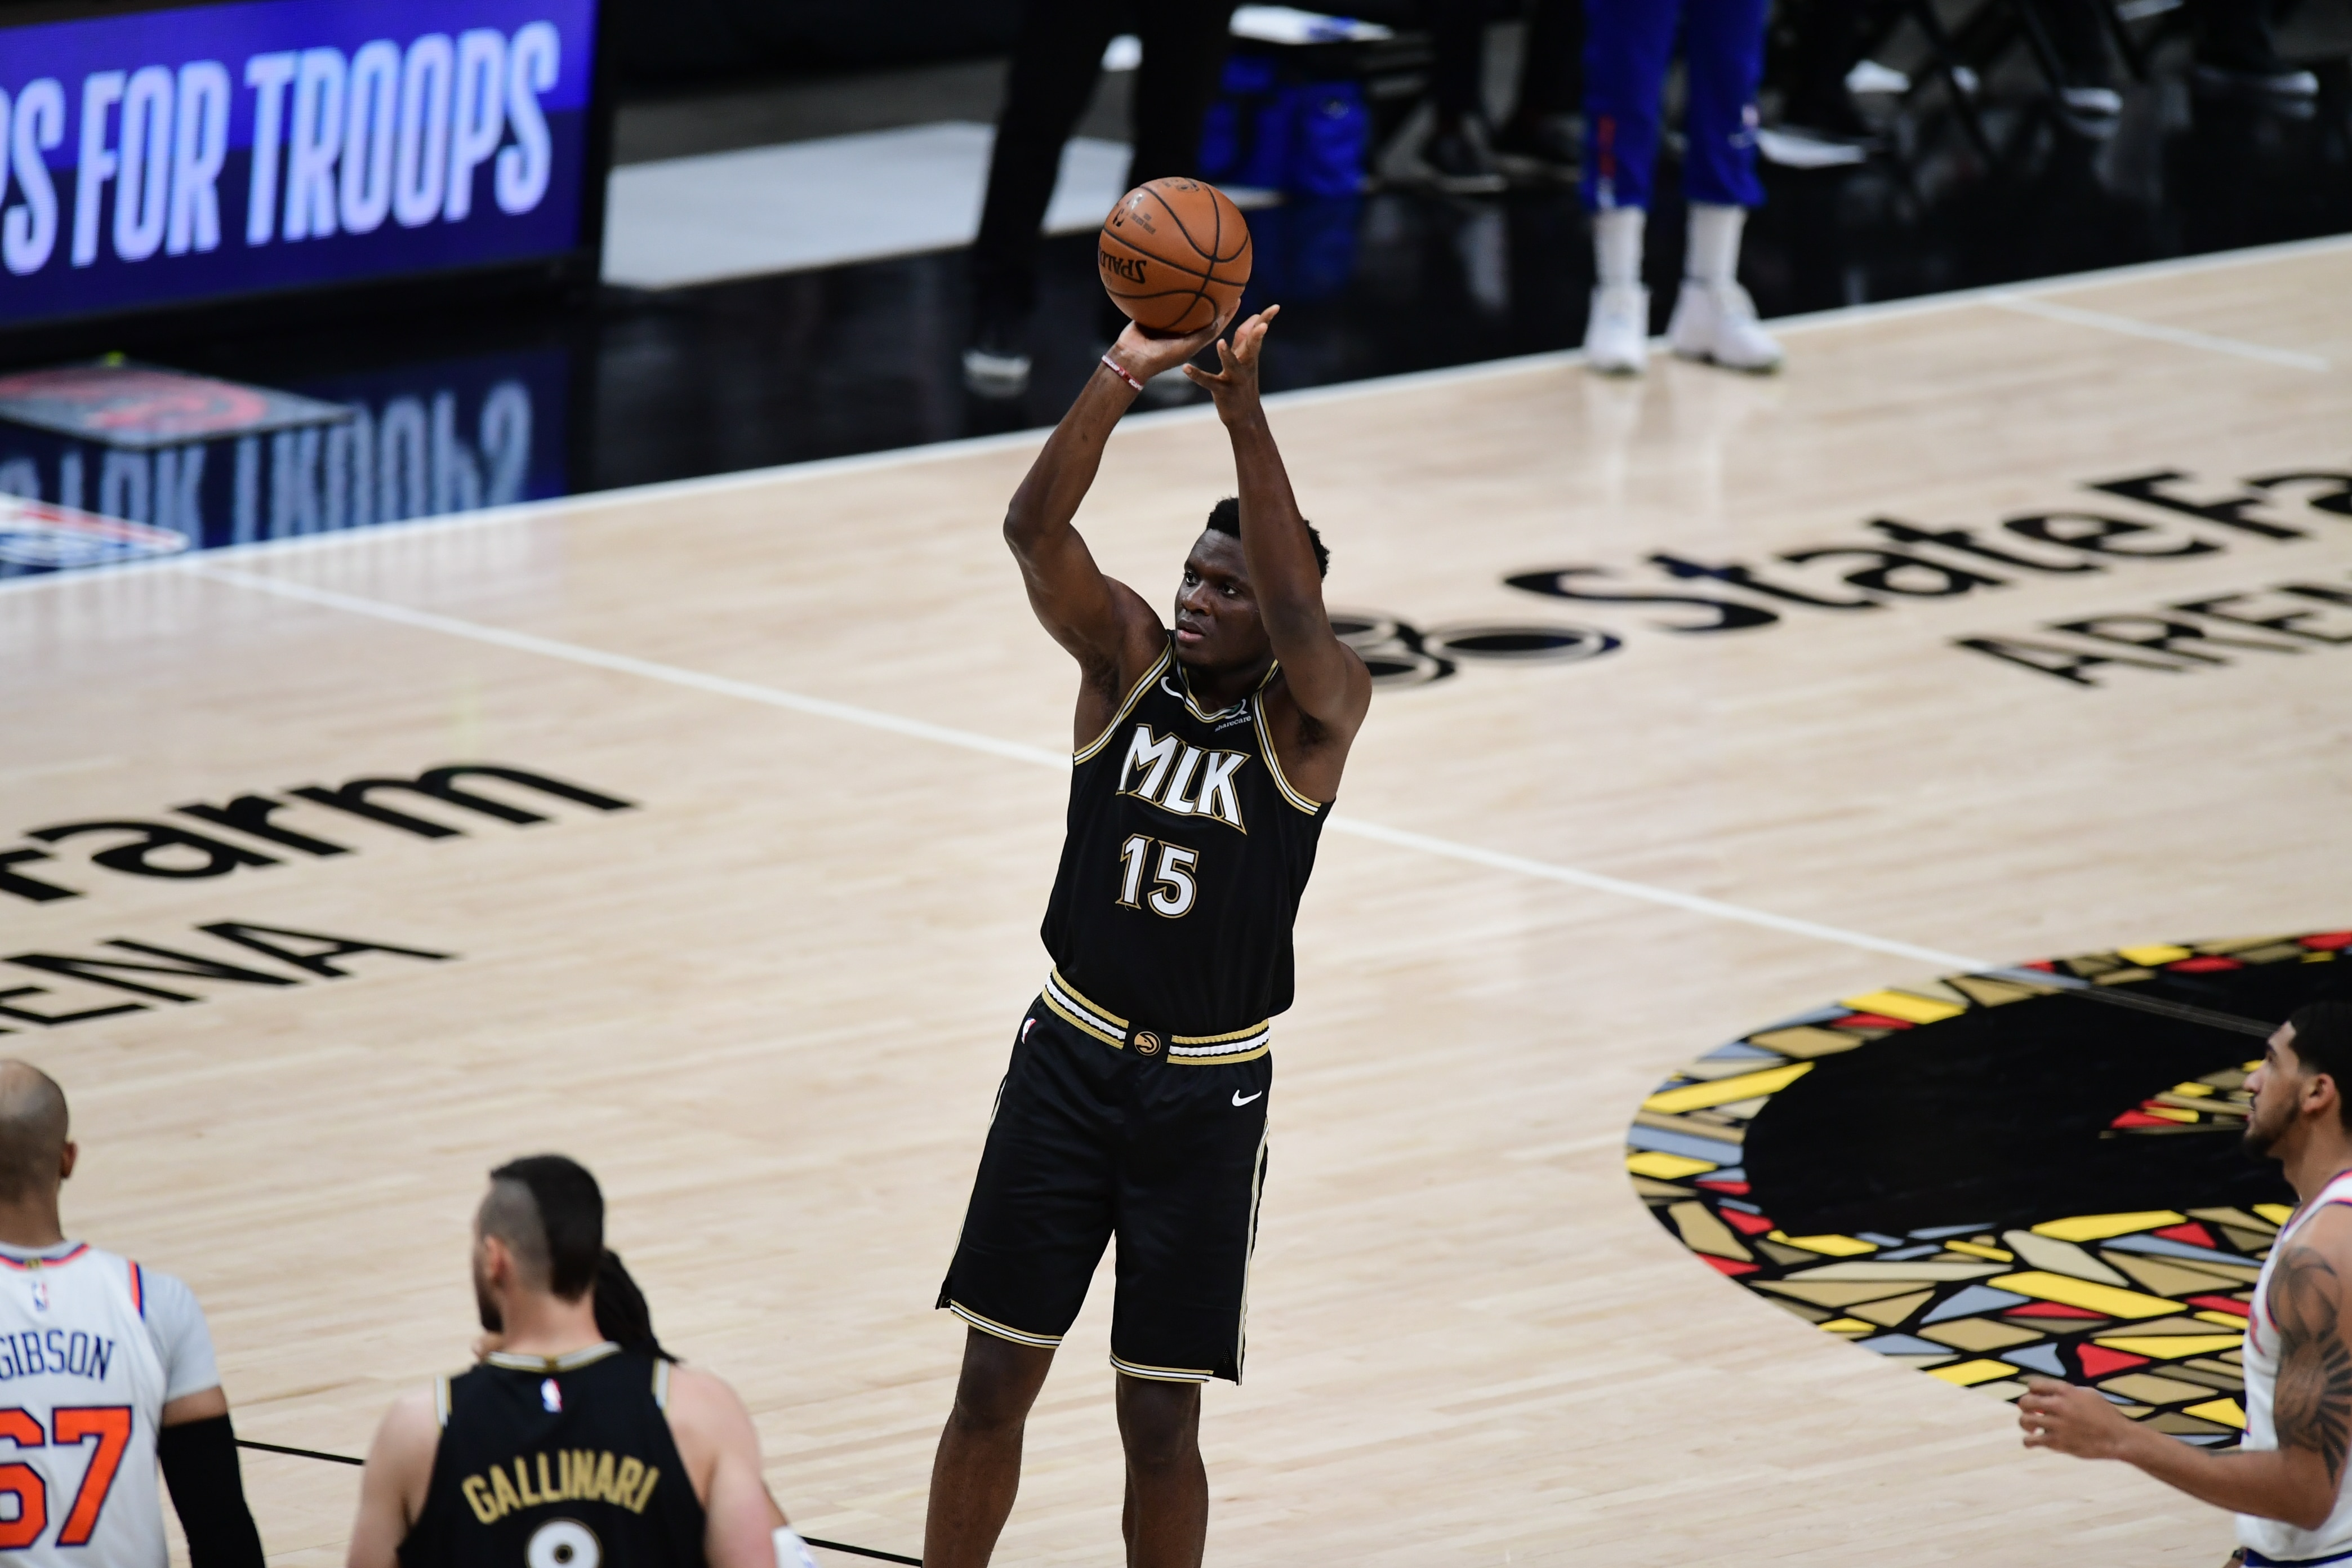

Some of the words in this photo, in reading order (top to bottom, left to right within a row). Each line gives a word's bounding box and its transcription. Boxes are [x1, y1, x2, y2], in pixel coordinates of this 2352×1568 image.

[0, 77, 65, 276] S
[70, 65, 230, 268] FOR
[244, 20, 561, 247] TROOPS
[1099, 250, 1147, 284] SPALD
[1214, 715, 1251, 733] sharecare
[1116, 723, 1251, 835] MLK
[1115, 833, 1199, 919] 15
[0, 1404, 132, 1550] 67
[461, 1448, 660, 1526] GALLINARI
